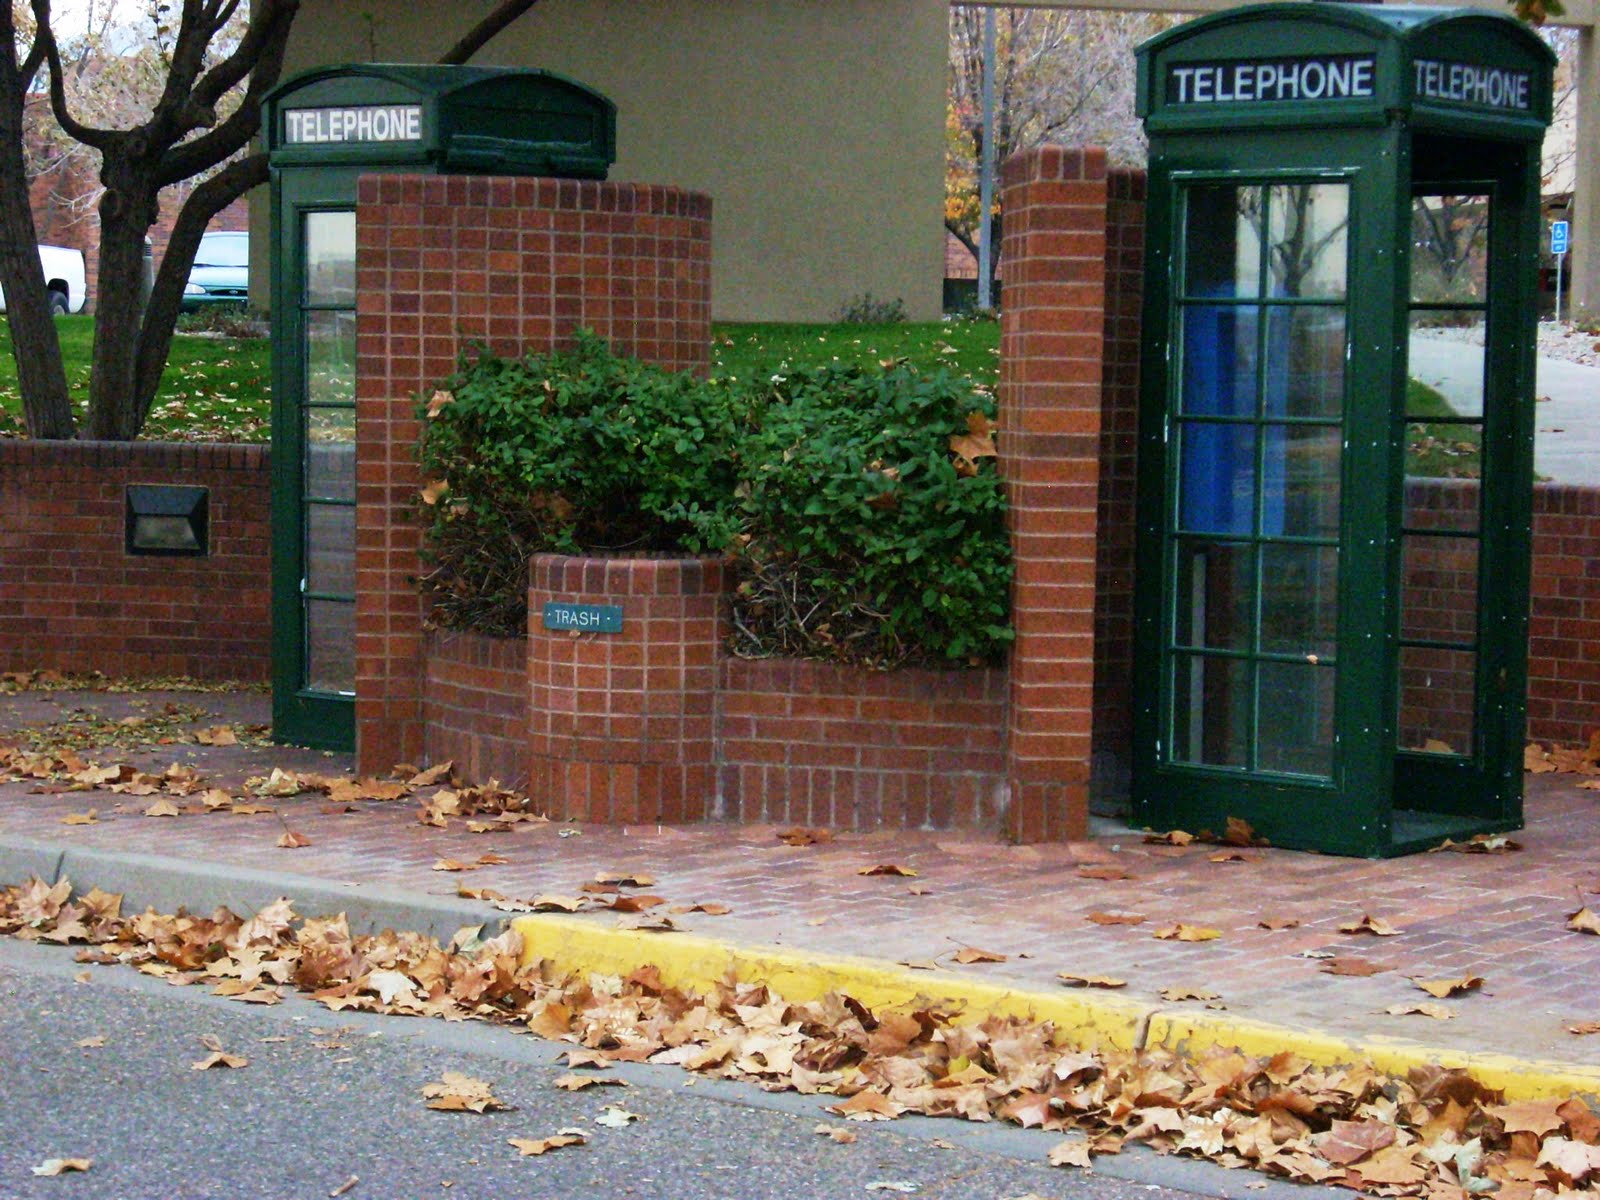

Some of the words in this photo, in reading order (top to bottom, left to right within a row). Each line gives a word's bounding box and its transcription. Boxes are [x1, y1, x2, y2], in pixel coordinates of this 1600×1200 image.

[1173, 61, 1373, 102] TELEPHONE
[1414, 60, 1528, 108] TELEPHONE
[288, 108, 421, 142] TELEPHONE
[554, 609, 600, 625] TRASH
